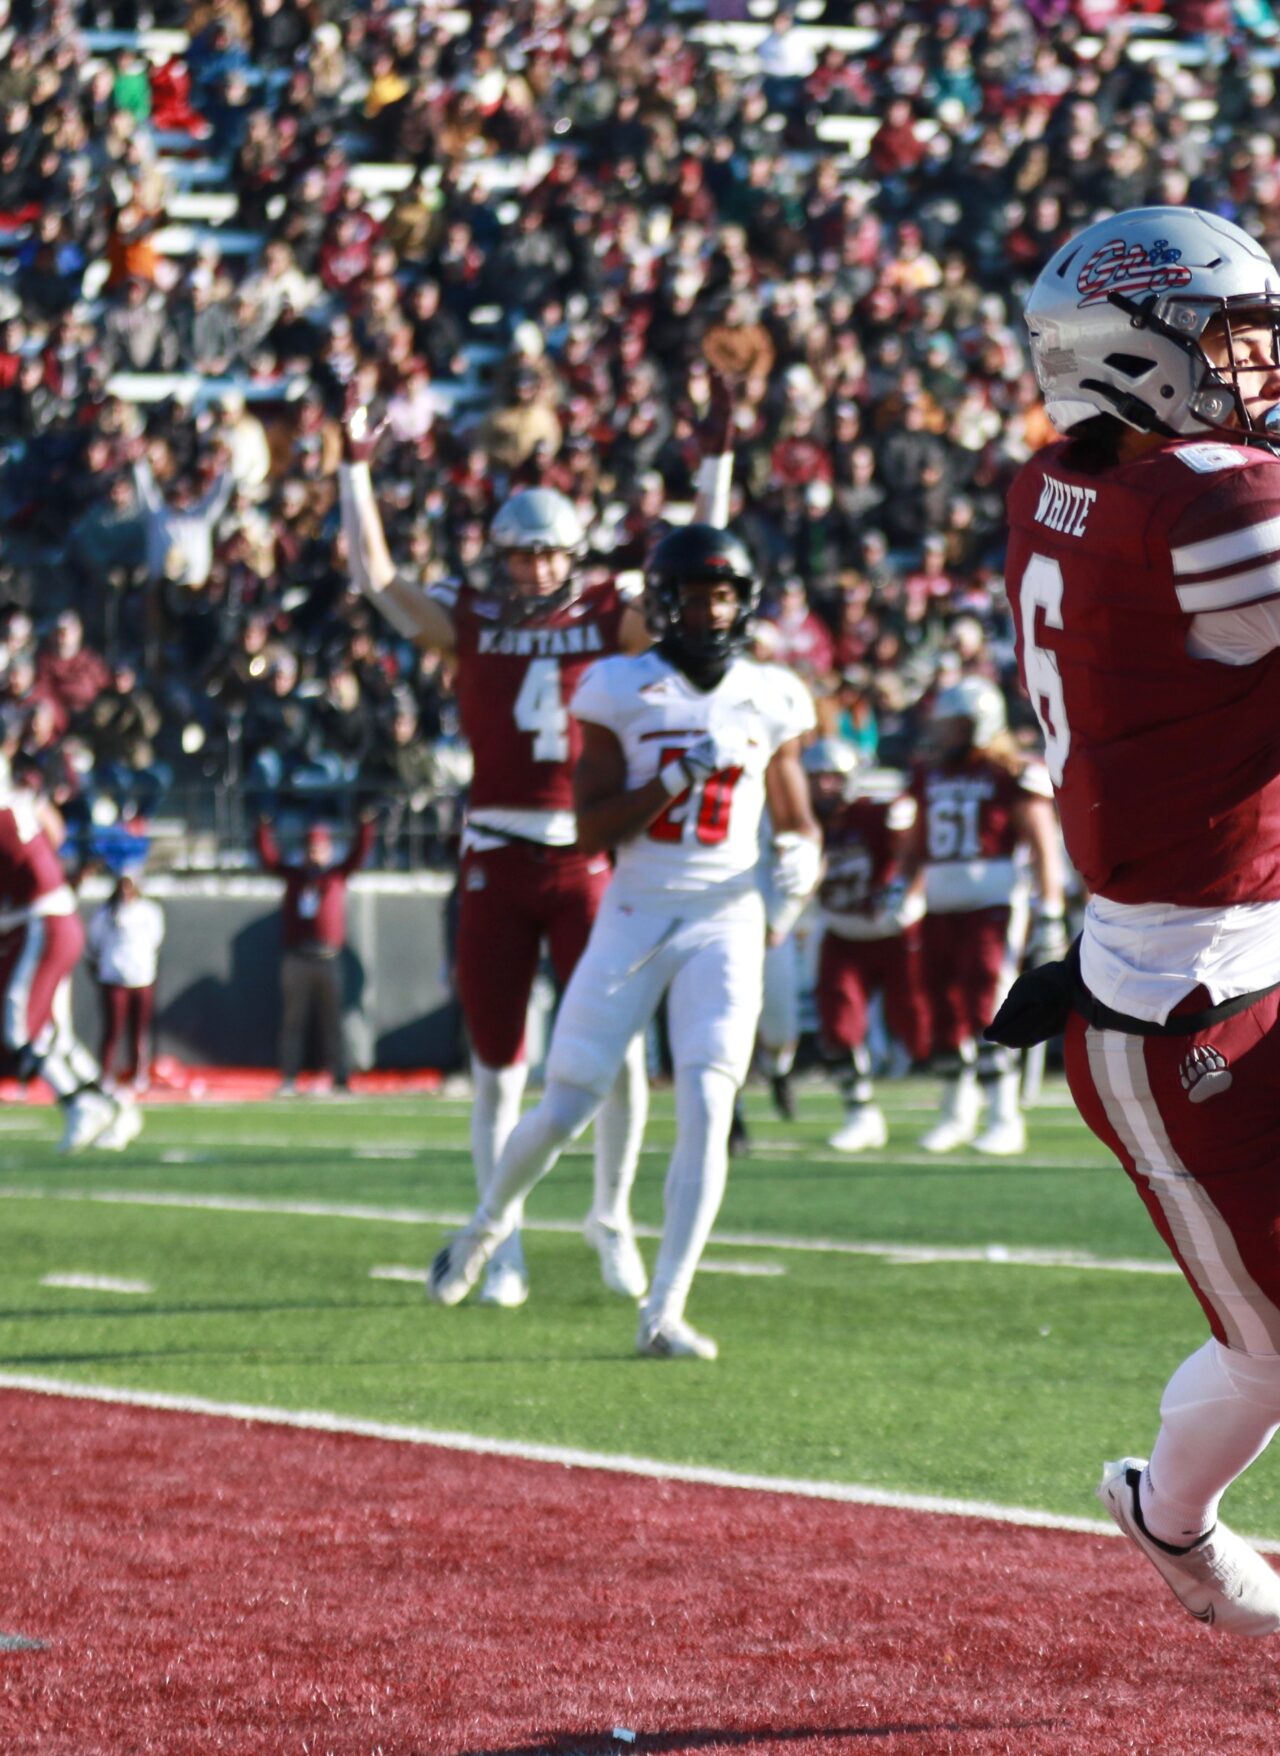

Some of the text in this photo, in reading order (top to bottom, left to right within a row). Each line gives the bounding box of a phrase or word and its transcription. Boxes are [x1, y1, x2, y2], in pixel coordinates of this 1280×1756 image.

[1034, 473, 1097, 538] WHITE
[513, 657, 569, 762] 4
[1020, 552, 1071, 789] 6
[926, 795, 983, 858] 61
